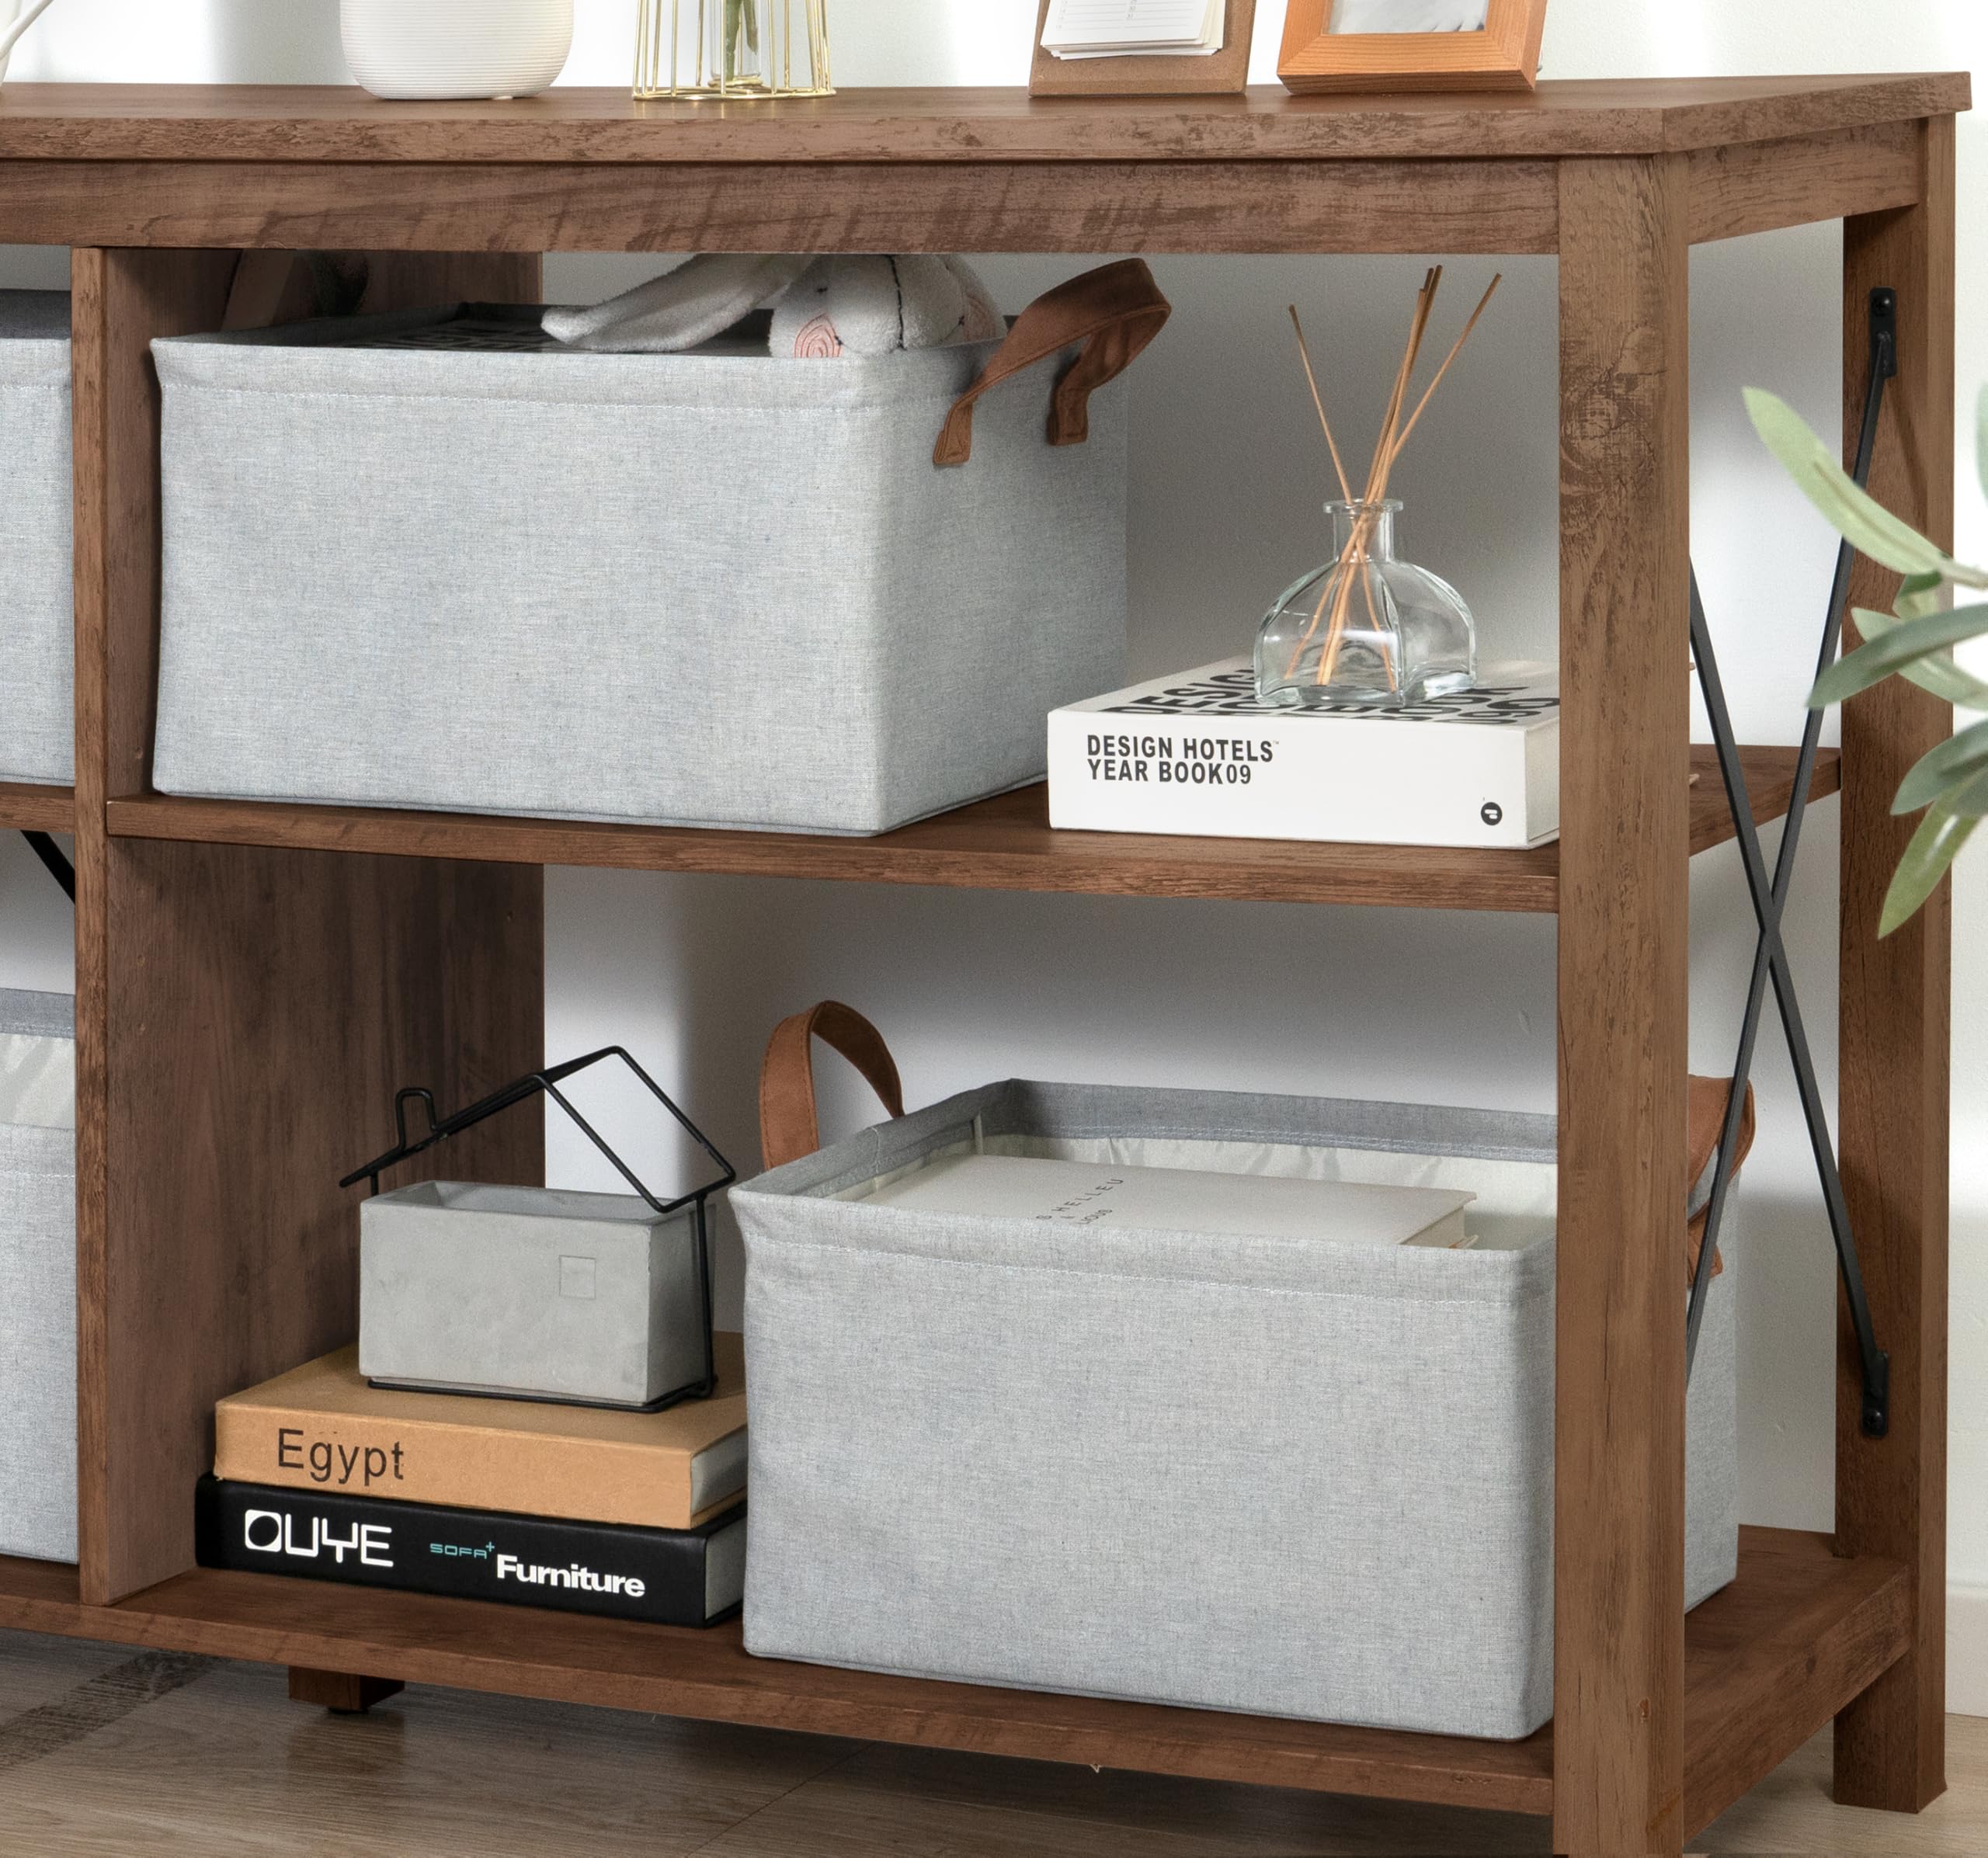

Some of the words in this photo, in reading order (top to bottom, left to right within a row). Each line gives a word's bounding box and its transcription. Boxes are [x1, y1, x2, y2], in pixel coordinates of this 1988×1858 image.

[1087, 735, 1173, 759] DESIGN
[1087, 759, 1149, 782] YEAR
[278, 1428, 405, 1487] Egypt
[245, 1509, 394, 1568] OUYE
[496, 1554, 646, 1597] Furniture
